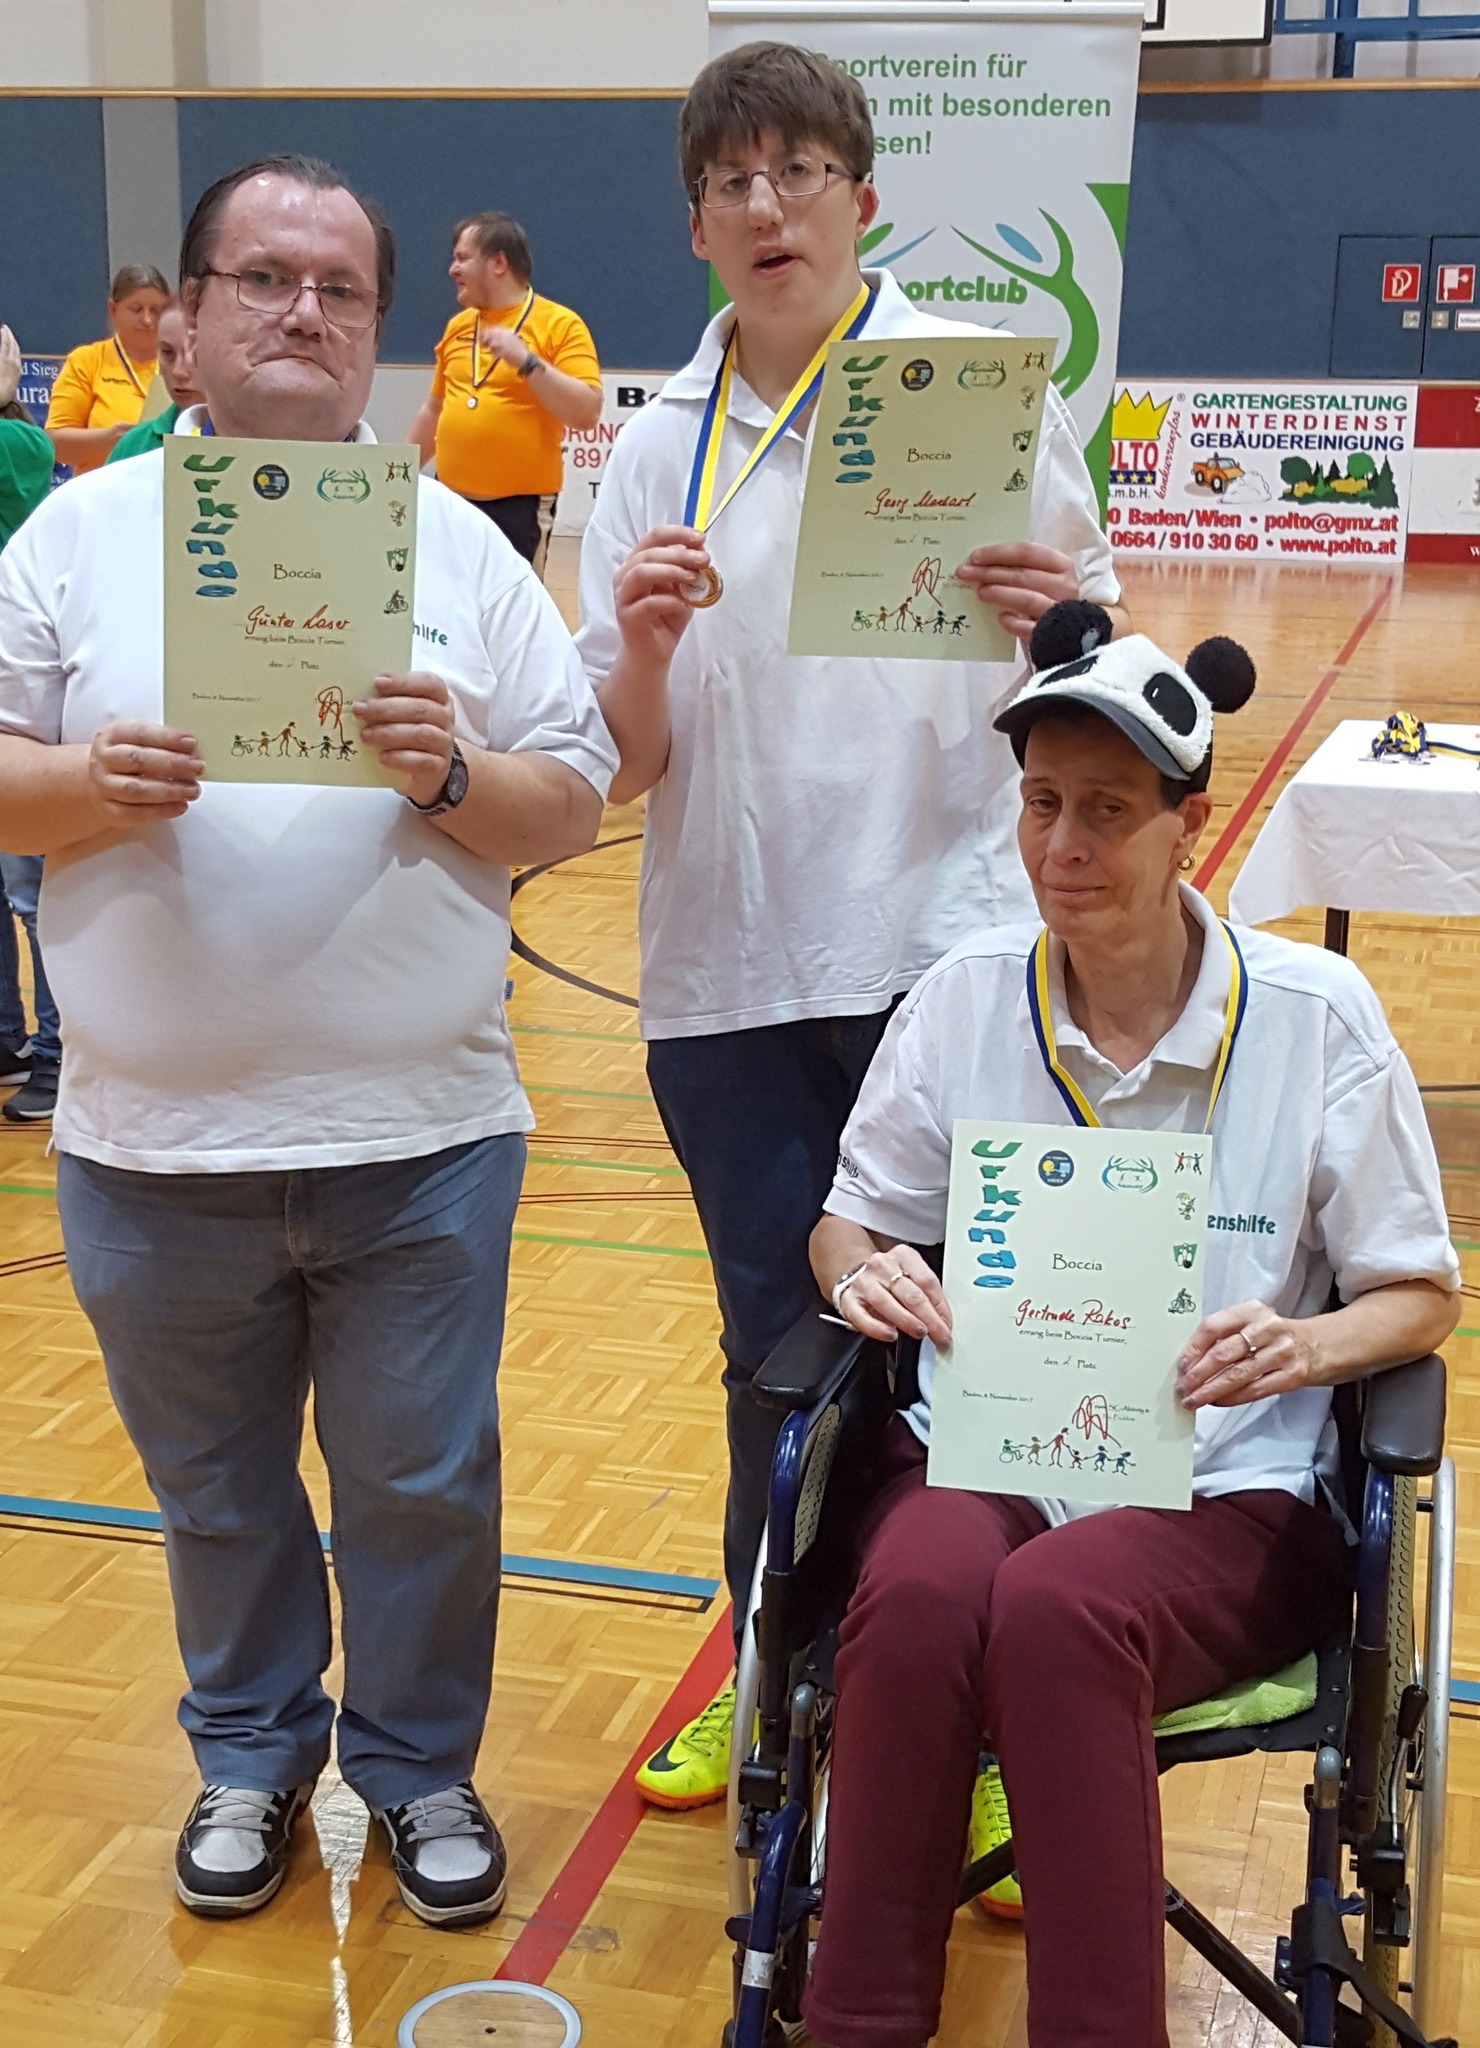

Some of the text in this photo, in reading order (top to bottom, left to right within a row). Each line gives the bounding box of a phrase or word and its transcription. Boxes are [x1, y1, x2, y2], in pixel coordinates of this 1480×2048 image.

[987, 53, 1028, 78] für
[889, 92, 933, 116] mit
[943, 92, 1111, 117] besonderen
[897, 276, 1028, 305] ortclub
[1193, 393, 1407, 411] GARTENGESTALTUNG
[1191, 413, 1407, 431] WINTERDIENST
[1190, 430, 1404, 450] GEBÄUDEREINIGUNG
[907, 447, 952, 462] Boccia
[1154, 410, 1182, 500] konkurrenzlos
[183, 454, 240, 598] Urkunde
[1128, 508, 1242, 528] Baden/Wien
[1264, 512, 1398, 535] polto@gmx.at
[1208, 533, 1232, 550] 30
[1234, 534, 1259, 551] 60
[1280, 536, 1397, 557] www.polto.at
[273, 563, 322, 580] Boccia
[968, 1139, 1023, 1289] Urkunde
[1052, 1253, 1103, 1271] Boccia
[1064, 1330, 1094, 1341] Boccia
